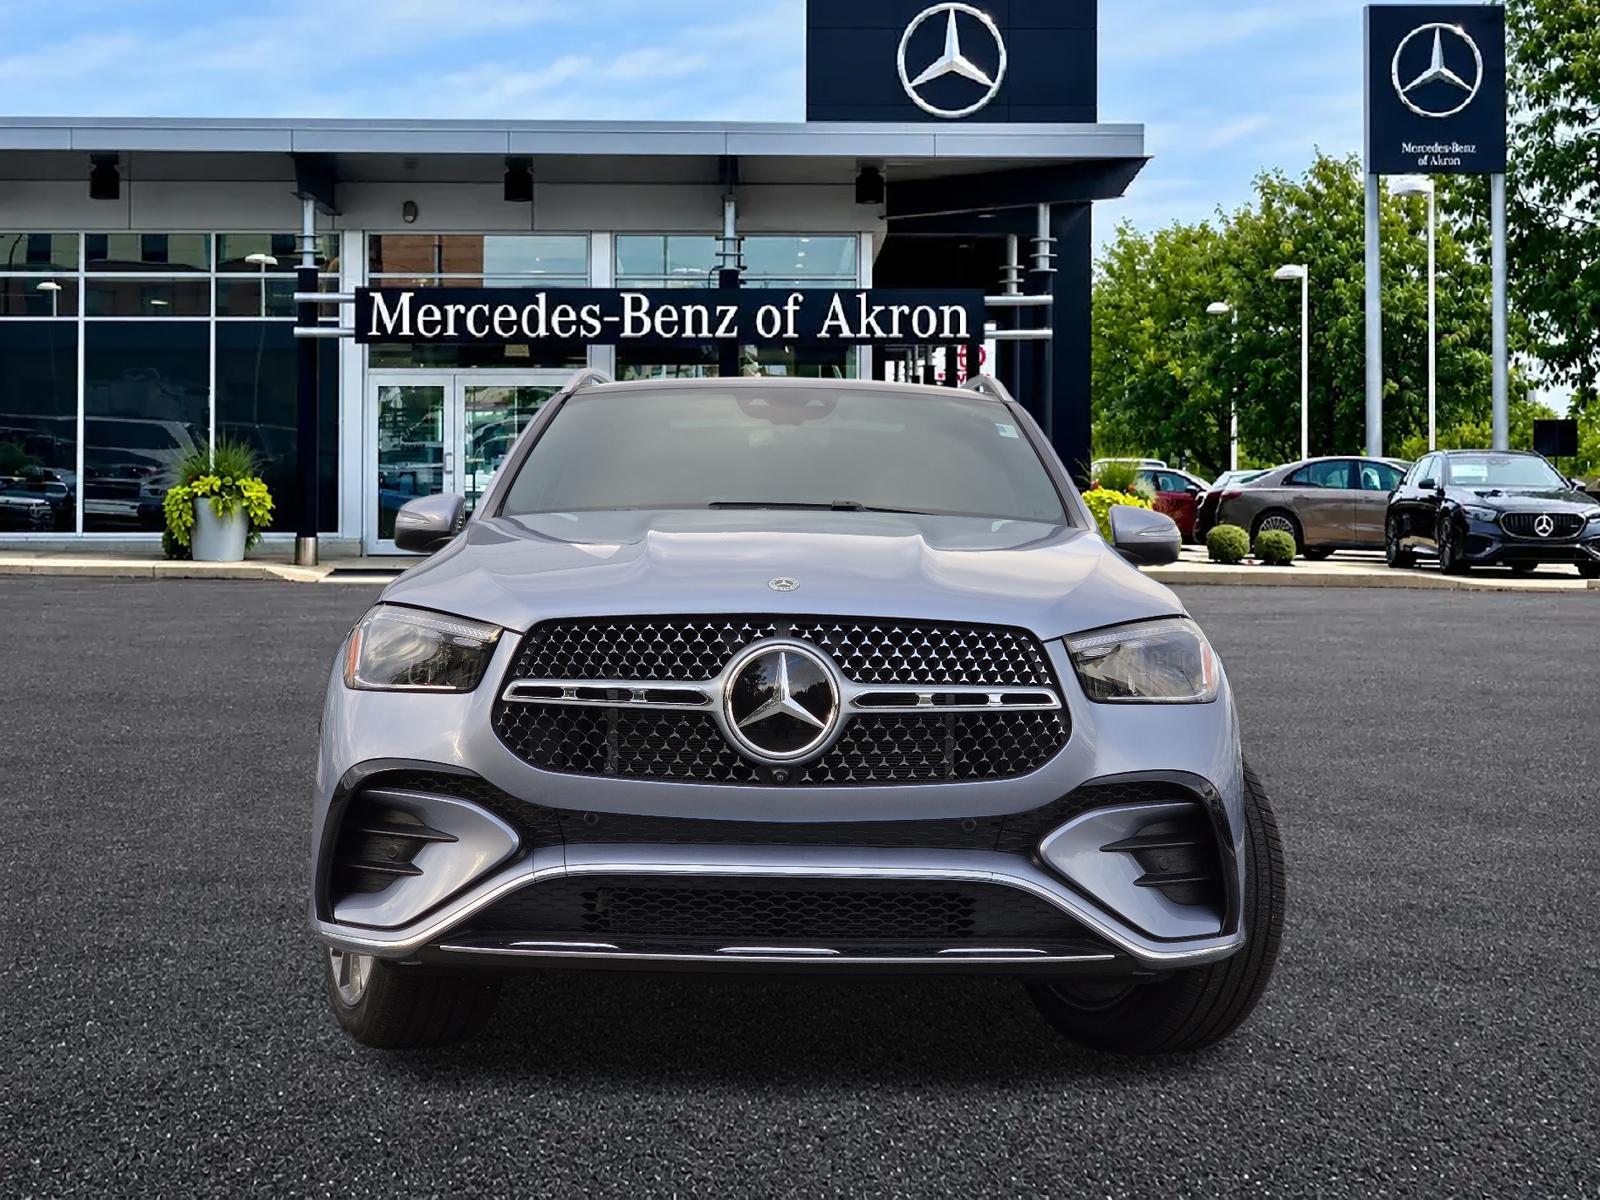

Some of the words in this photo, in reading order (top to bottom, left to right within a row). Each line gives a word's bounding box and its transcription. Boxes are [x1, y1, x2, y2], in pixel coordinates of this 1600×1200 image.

[1401, 141, 1477, 154] Mercedes-Benz
[1417, 154, 1429, 166] of
[1430, 154, 1461, 166] Akron
[367, 291, 738, 339] Mercedes-Benz
[755, 291, 804, 339] of
[815, 291, 971, 339] Akron
